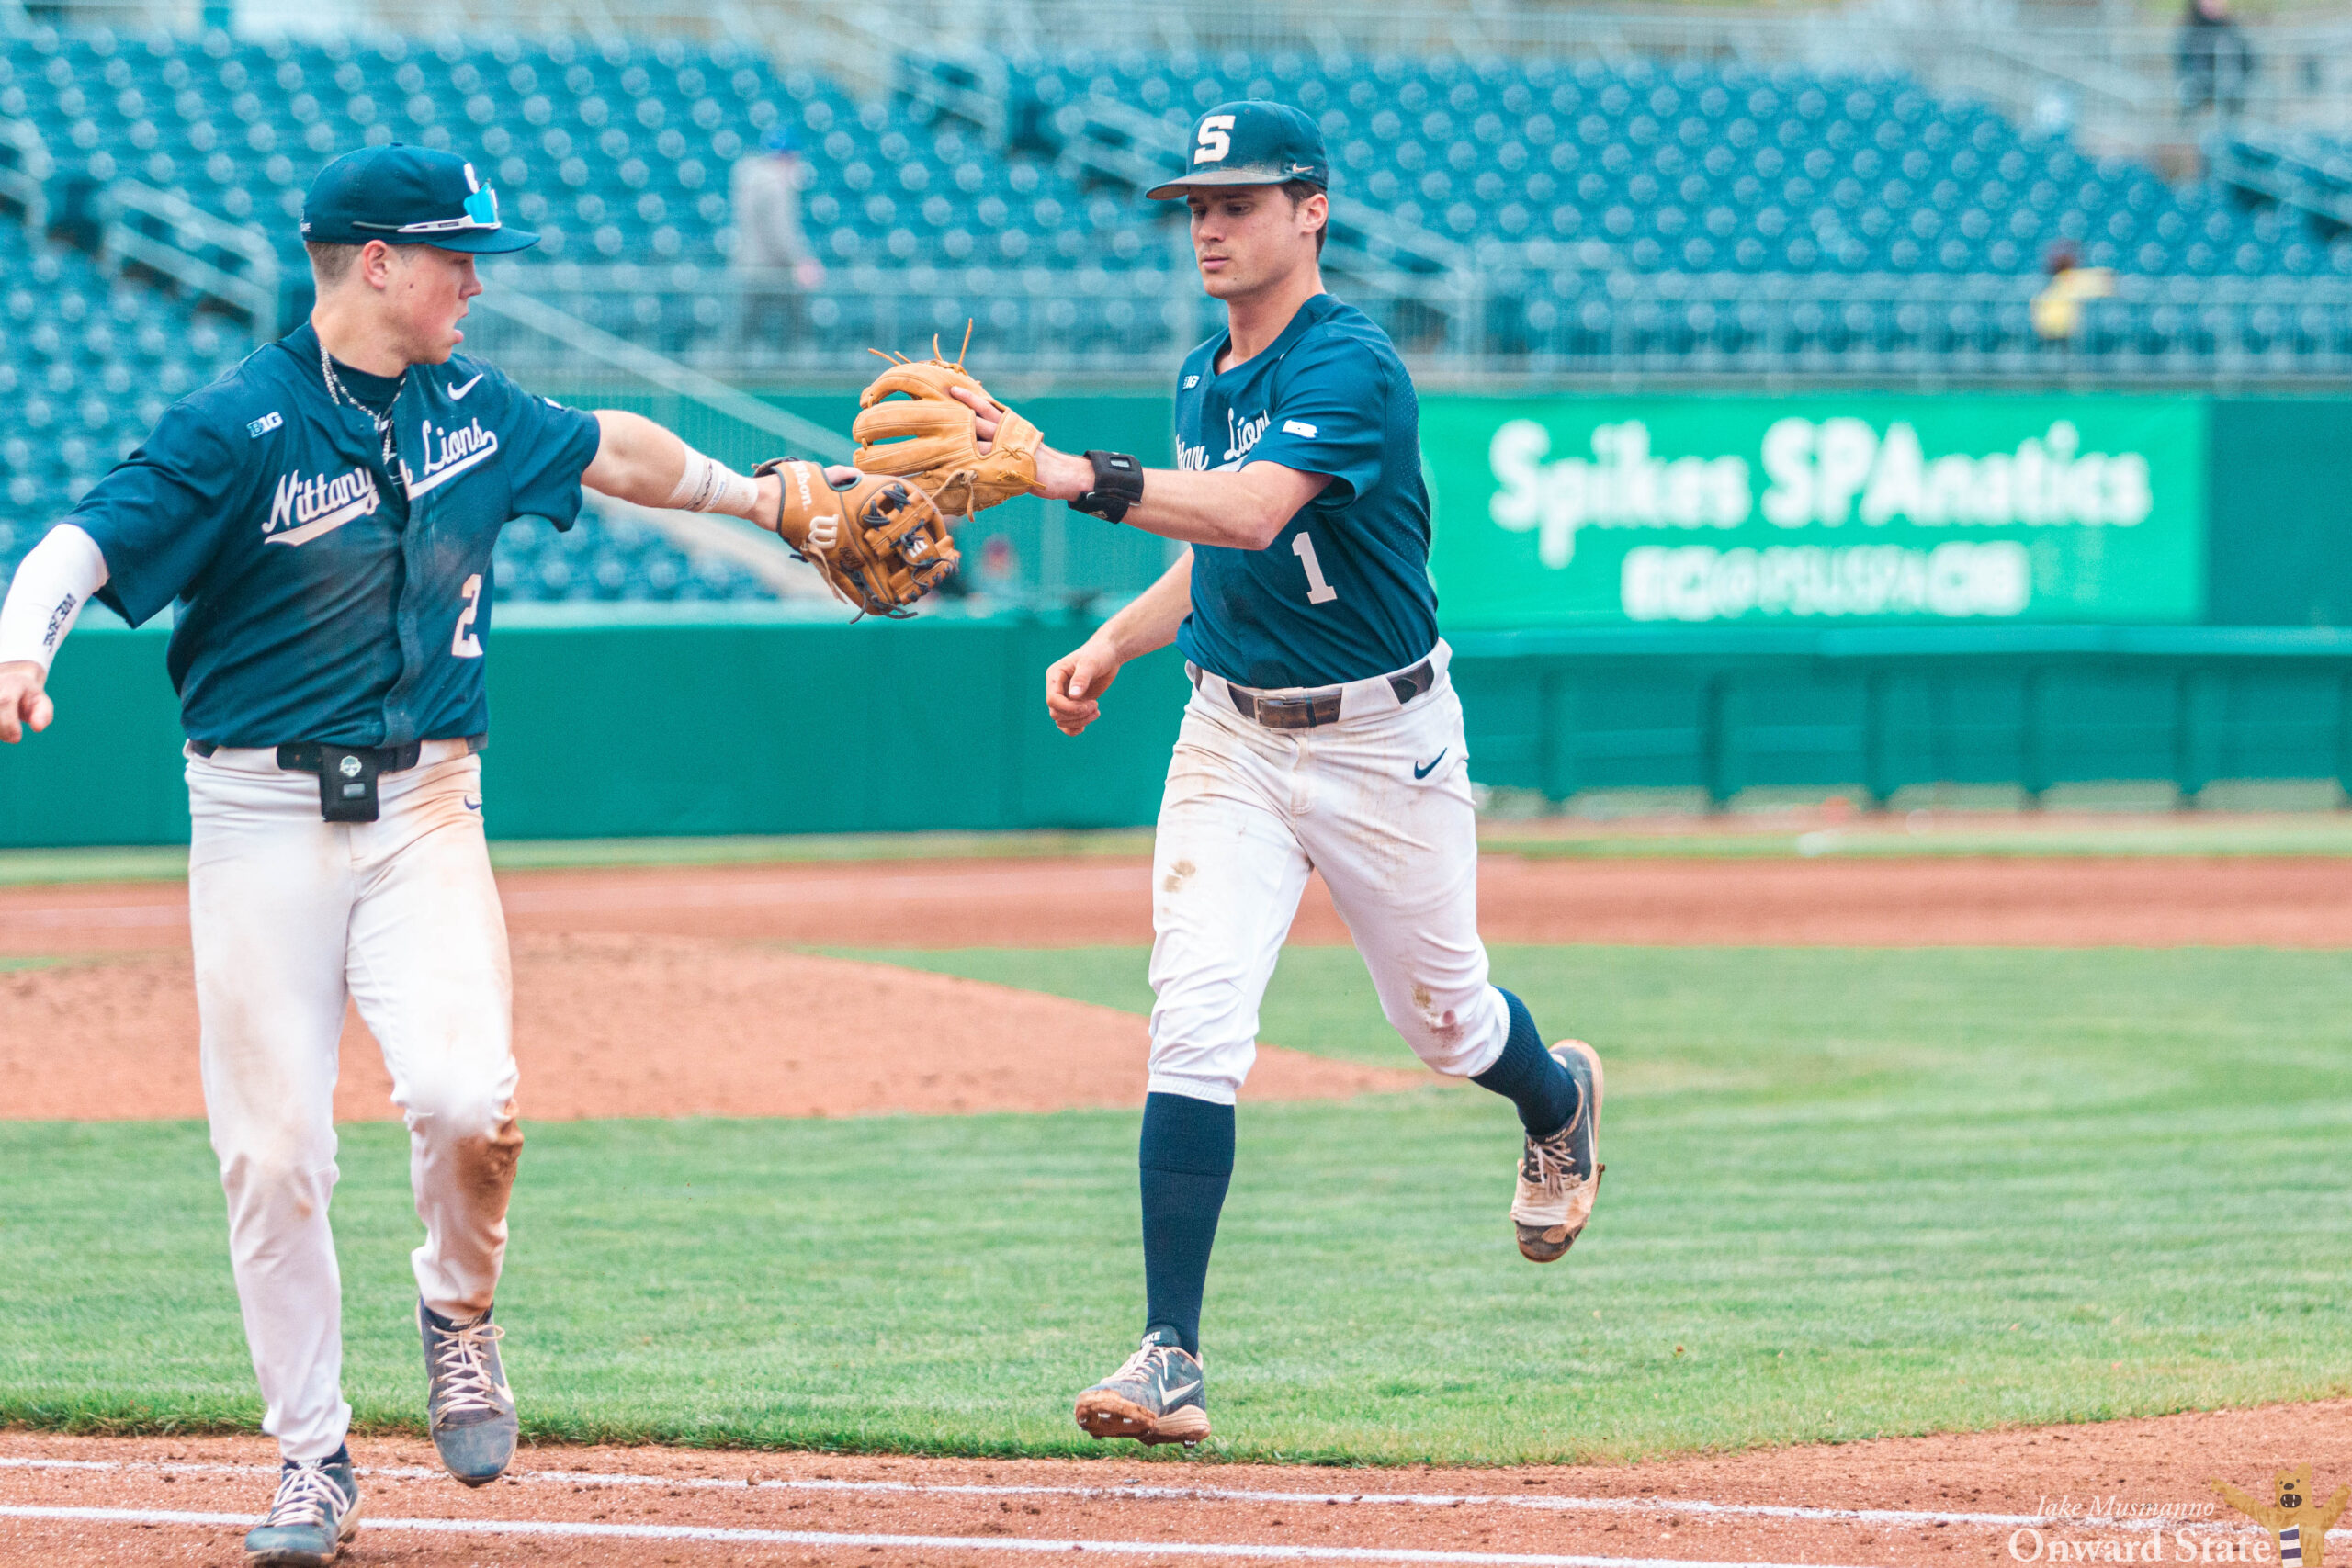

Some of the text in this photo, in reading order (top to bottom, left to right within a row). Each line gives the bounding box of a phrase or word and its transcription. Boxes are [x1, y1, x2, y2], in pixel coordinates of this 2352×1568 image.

[1193, 115, 1236, 164] S
[422, 416, 498, 476] Lions
[1490, 419, 1750, 568] Spikes
[1291, 532, 1338, 605] 1
[451, 573, 484, 658] 2
